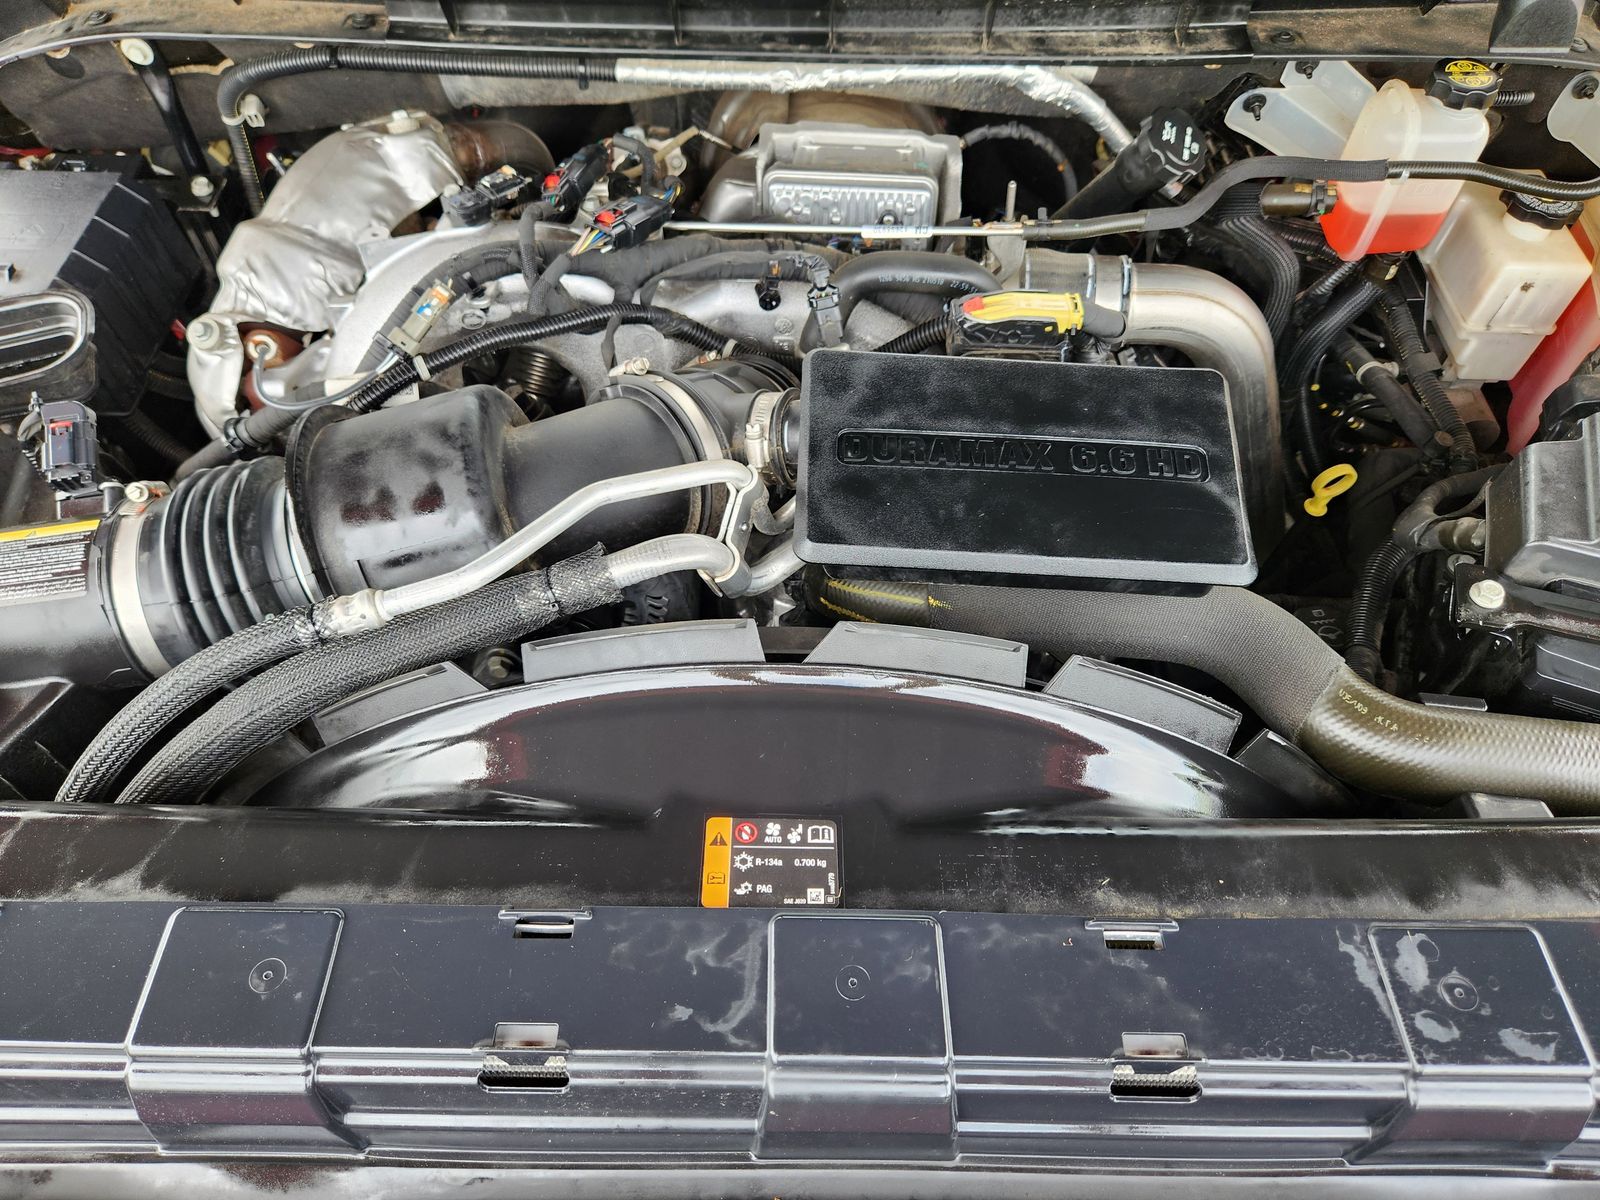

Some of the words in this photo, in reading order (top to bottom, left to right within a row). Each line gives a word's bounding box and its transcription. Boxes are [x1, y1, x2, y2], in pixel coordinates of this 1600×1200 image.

[843, 435, 1054, 471] DURAMAX
[1070, 444, 1137, 476] 6.6
[1147, 447, 1203, 480] HD
[755, 858, 783, 867] R-134a
[794, 858, 815, 867] 0.700
[816, 858, 827, 868] kg
[756, 884, 773, 893] PAG
